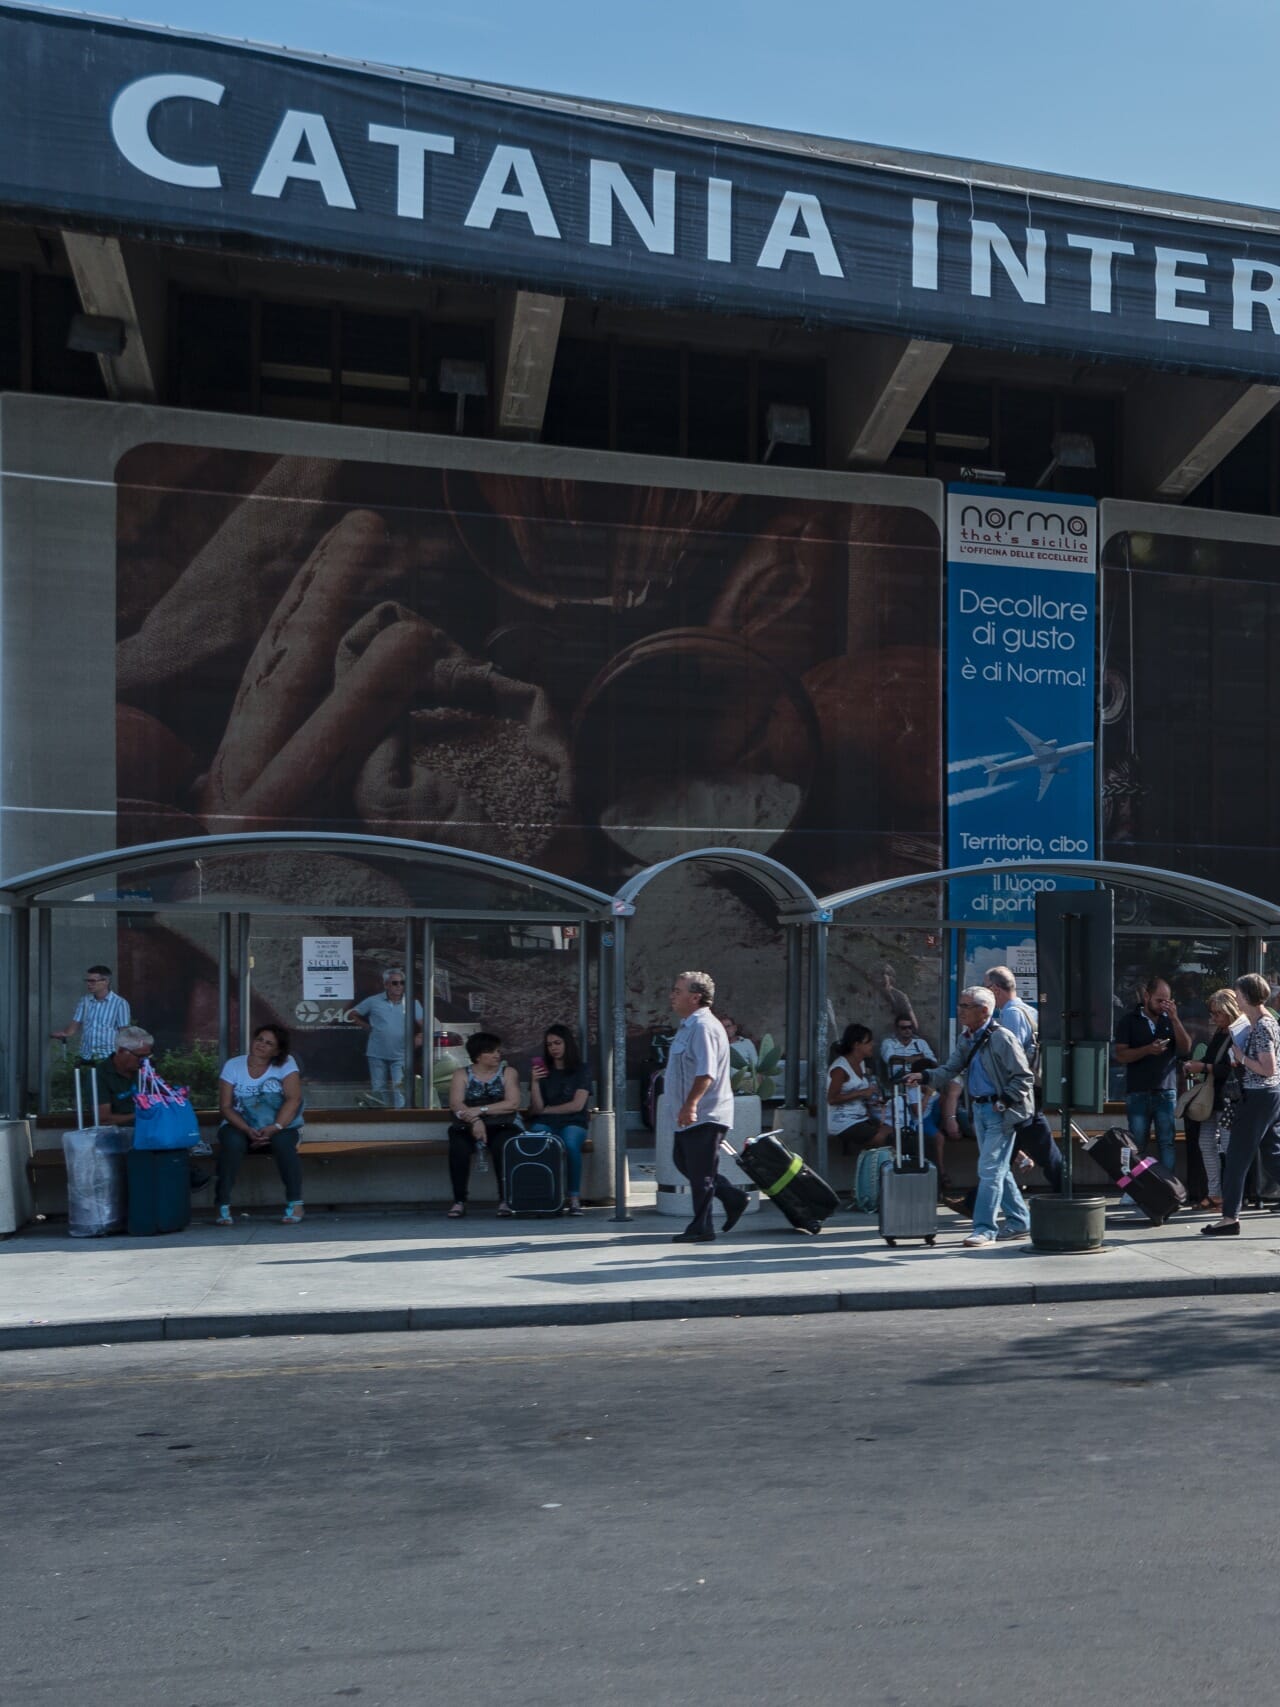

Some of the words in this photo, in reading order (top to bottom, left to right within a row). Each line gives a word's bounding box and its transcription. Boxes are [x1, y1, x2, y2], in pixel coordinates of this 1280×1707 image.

[110, 73, 844, 279] CATANIA
[960, 505, 1088, 537] norma
[960, 528, 1020, 544] that's
[1031, 536, 1088, 551] sicilia
[959, 545, 1008, 557] L'OFFICINA
[1010, 549, 1035, 560] DELLE
[1037, 551, 1089, 564] ECCELLENZE
[959, 588, 1088, 622] Decollare
[972, 621, 996, 646] di
[1002, 626, 1076, 654] gusto
[961, 656, 977, 680] è
[982, 661, 1002, 682] di
[1007, 662, 1087, 687] Norma!
[959, 832, 1045, 855] Territorio,
[1049, 836, 1089, 853] cibo
[992, 874, 1001, 891] il
[971, 894, 989, 911] di
[320, 1007, 358, 1023] SAC
